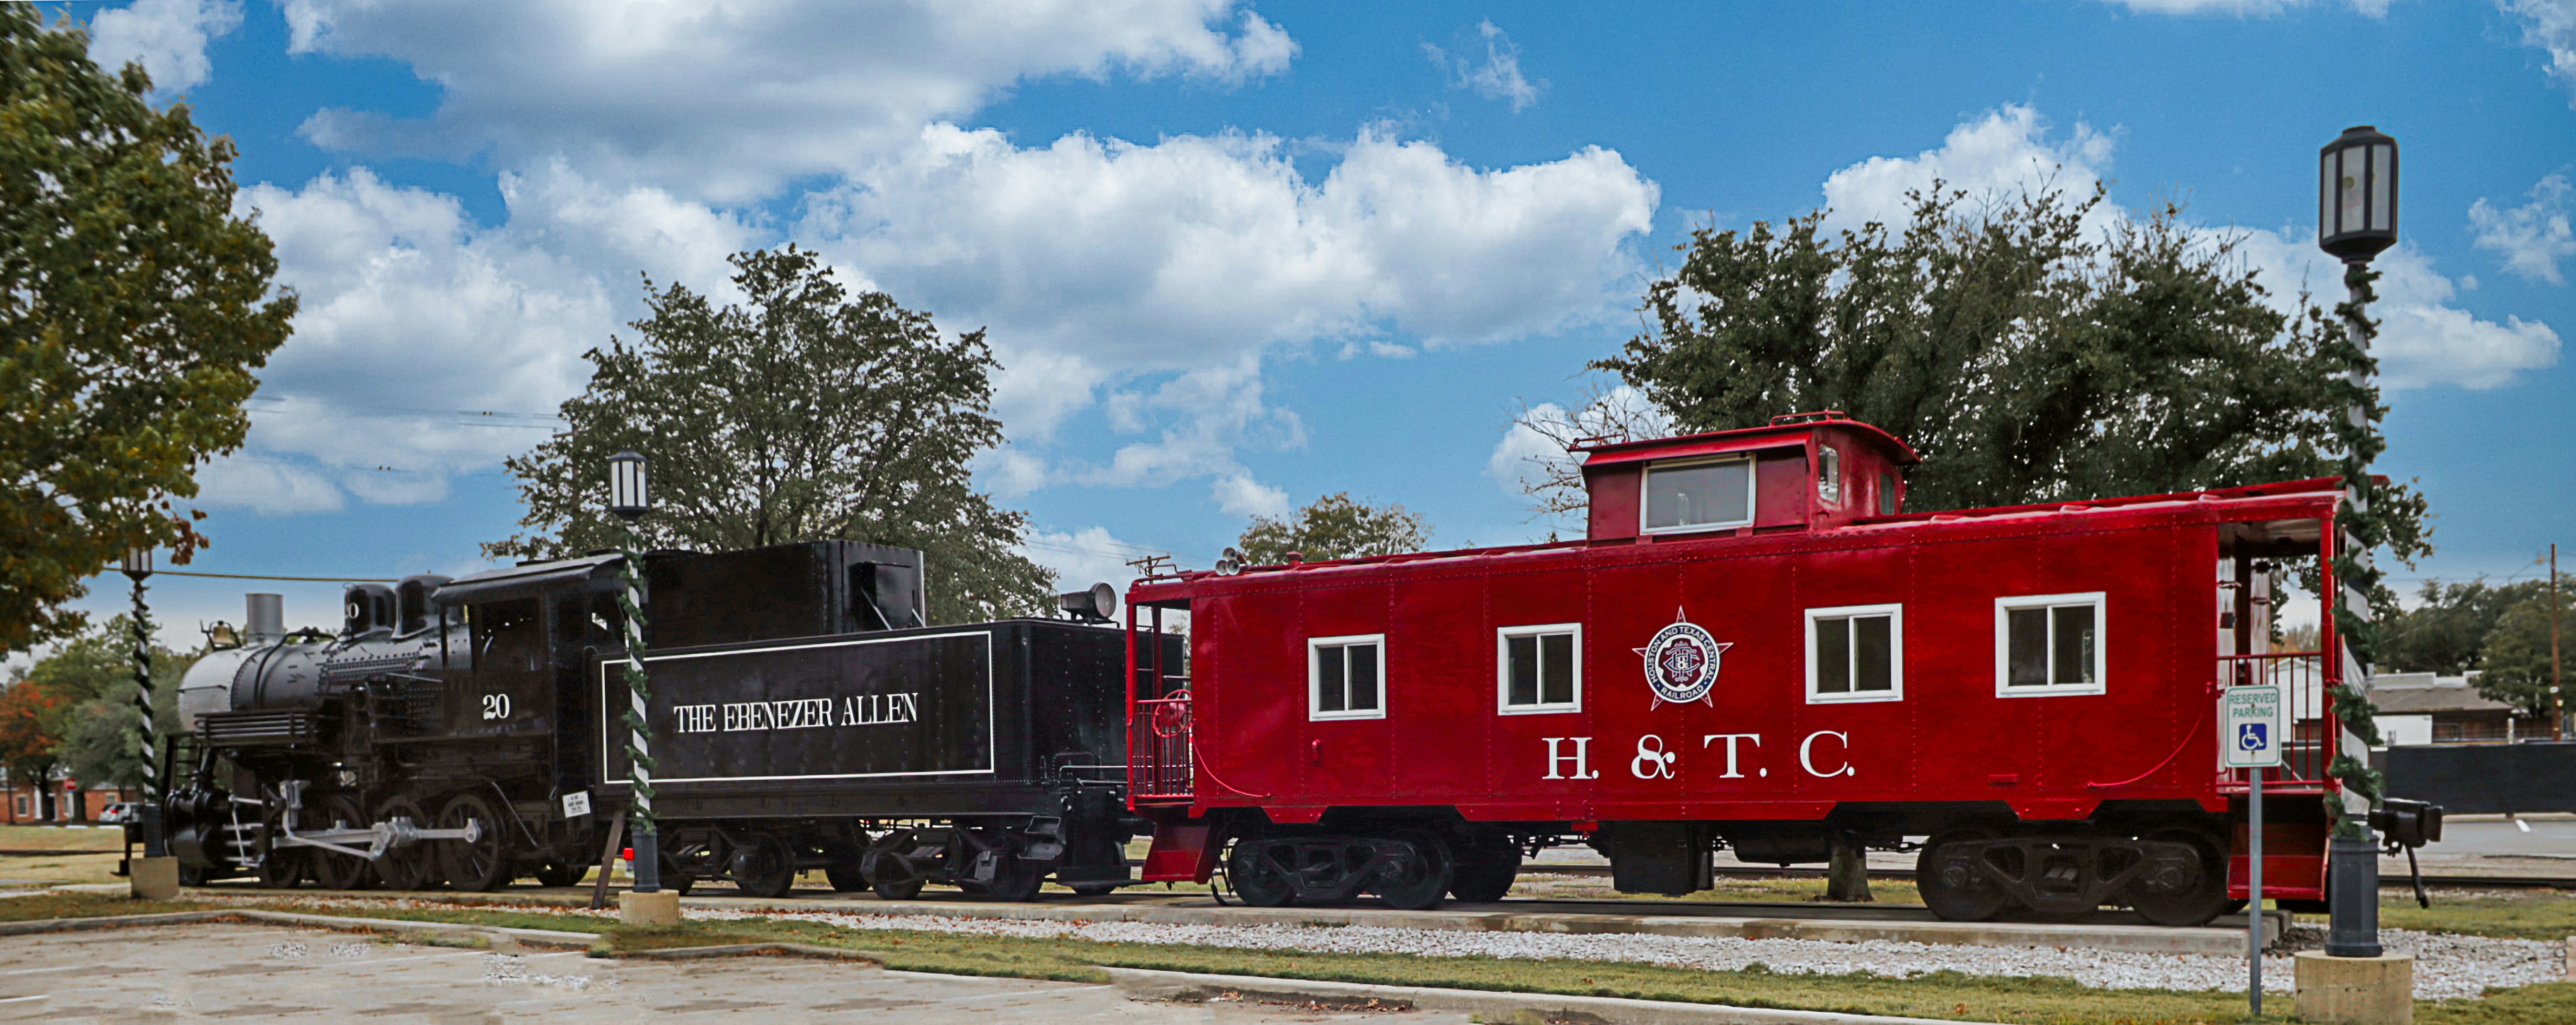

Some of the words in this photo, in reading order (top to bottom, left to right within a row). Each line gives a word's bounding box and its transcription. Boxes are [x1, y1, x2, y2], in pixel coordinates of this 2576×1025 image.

[1648, 640, 1660, 683] HOUSTON
[1660, 628, 1677, 641] AND
[1679, 626, 1705, 641] TEXAS
[1704, 640, 1715, 680] CENTRAL
[1660, 685, 1704, 699] RAILROAD
[2229, 693, 2277, 705] RESERVED
[483, 693, 510, 720] 20
[674, 705, 716, 732] THE
[723, 698, 833, 731] EBENEZER
[841, 693, 918, 726] ALLEN
[2233, 706, 2273, 718] PARKING
[1542, 737, 1599, 779] H.
[1631, 734, 1675, 779] &
[1704, 733, 1767, 778] T.
[1800, 730, 1855, 777] C.
